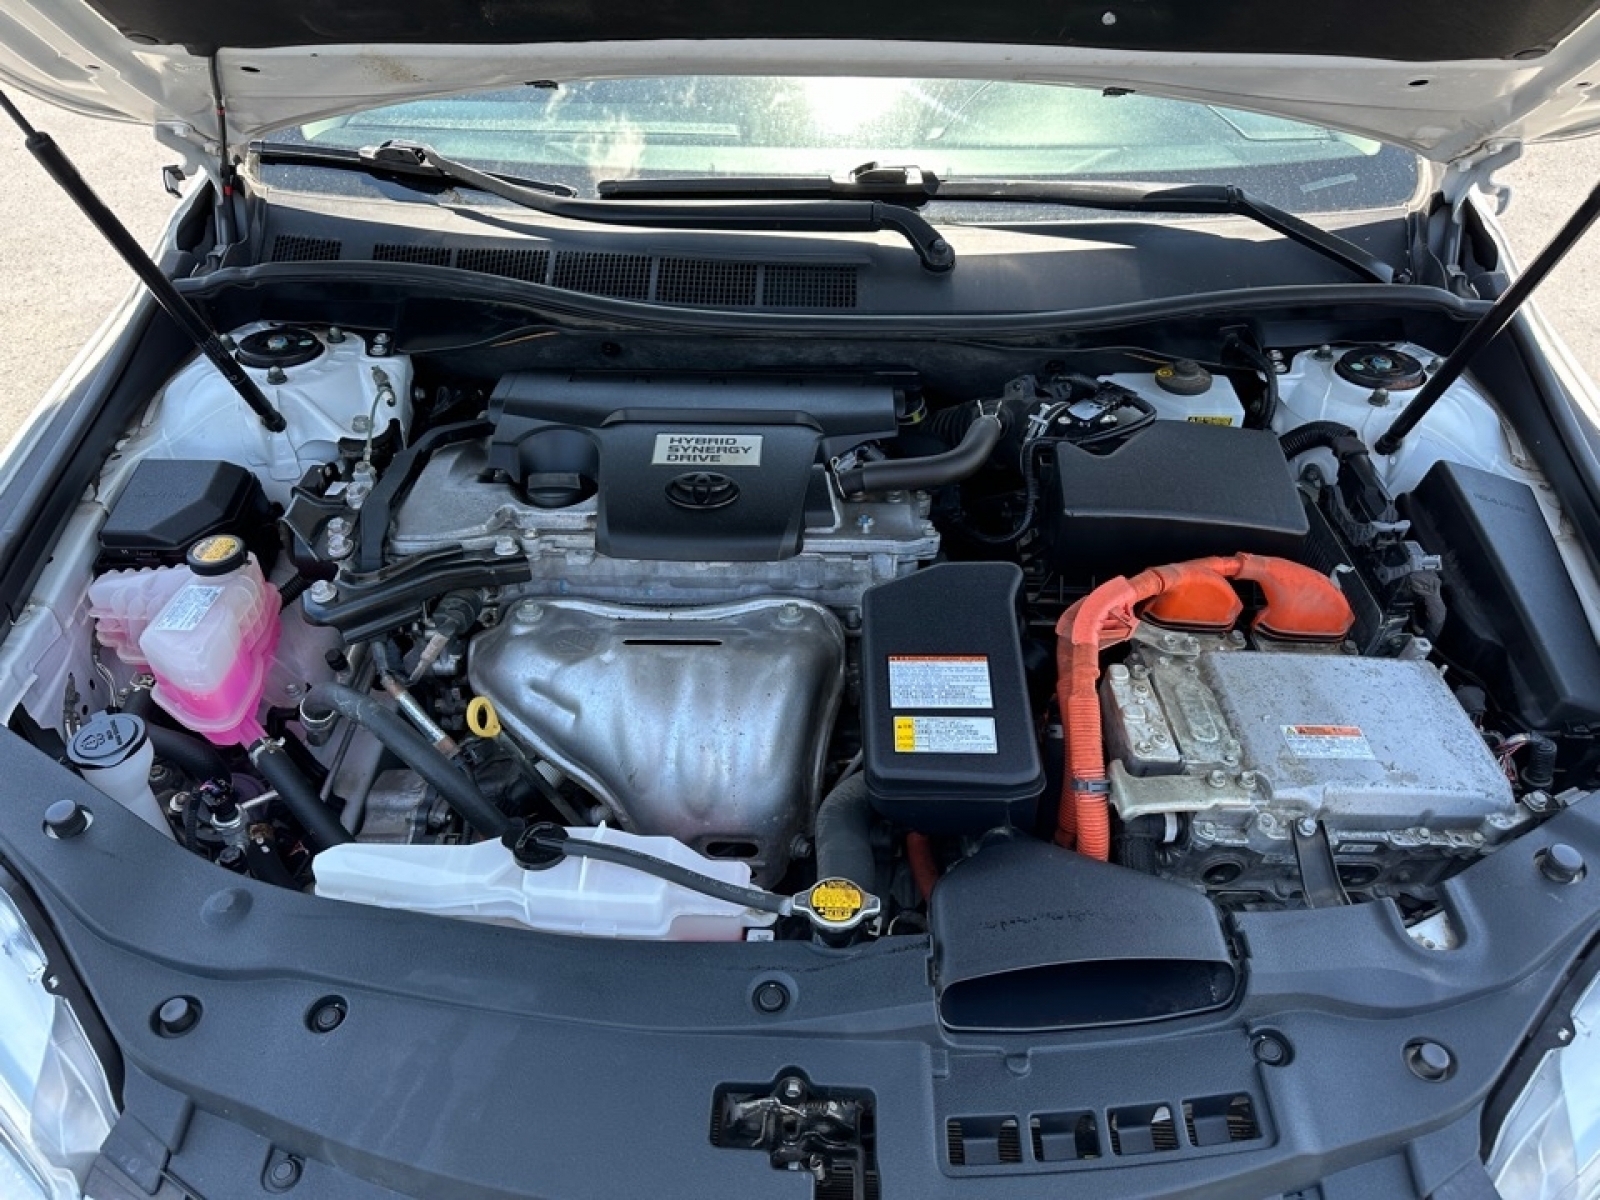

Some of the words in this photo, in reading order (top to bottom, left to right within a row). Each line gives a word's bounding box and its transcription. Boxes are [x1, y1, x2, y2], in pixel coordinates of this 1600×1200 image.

[669, 436, 738, 445] HYBRID
[667, 445, 753, 454] SYNERGY
[666, 454, 721, 462] DRIVE
